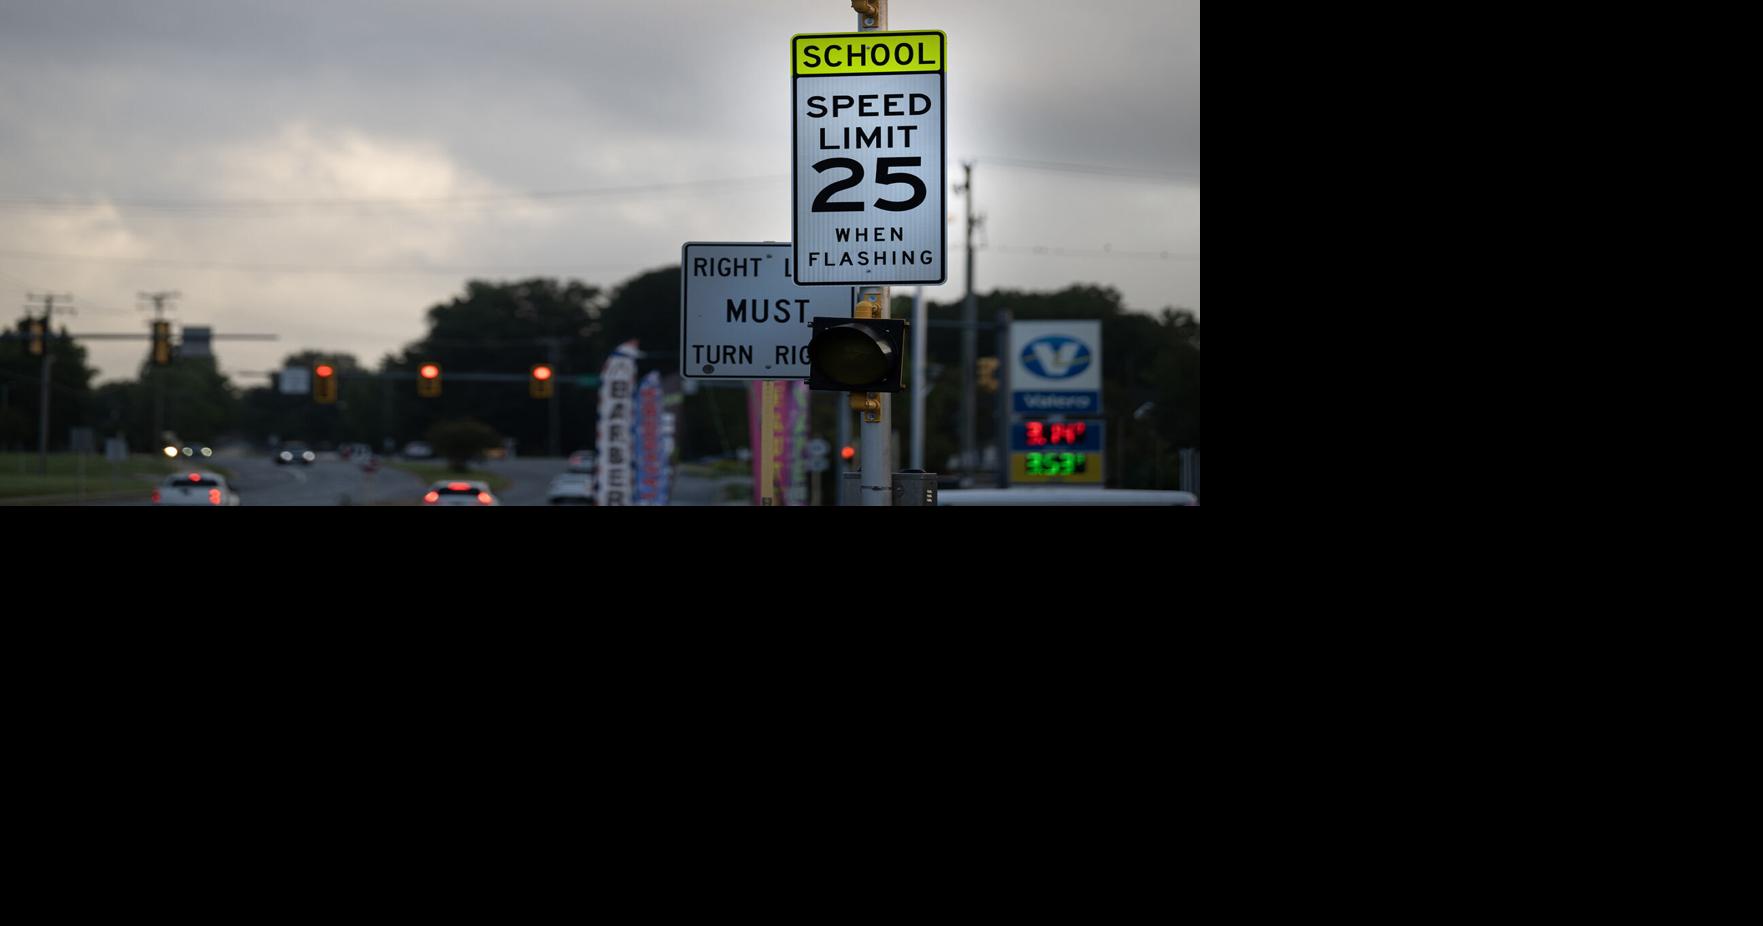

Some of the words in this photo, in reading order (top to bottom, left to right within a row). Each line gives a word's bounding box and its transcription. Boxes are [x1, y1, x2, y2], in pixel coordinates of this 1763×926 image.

[803, 42, 936, 68] SCHOOL
[806, 93, 932, 118] SPEED
[819, 125, 918, 150] LIMIT
[811, 156, 927, 213] 25
[835, 227, 904, 242] WHEN
[693, 257, 763, 277] RIGHT
[808, 250, 934, 267] FLASHING
[726, 299, 810, 323] MUST
[692, 345, 753, 365] TURN
[775, 345, 810, 365] RIG
